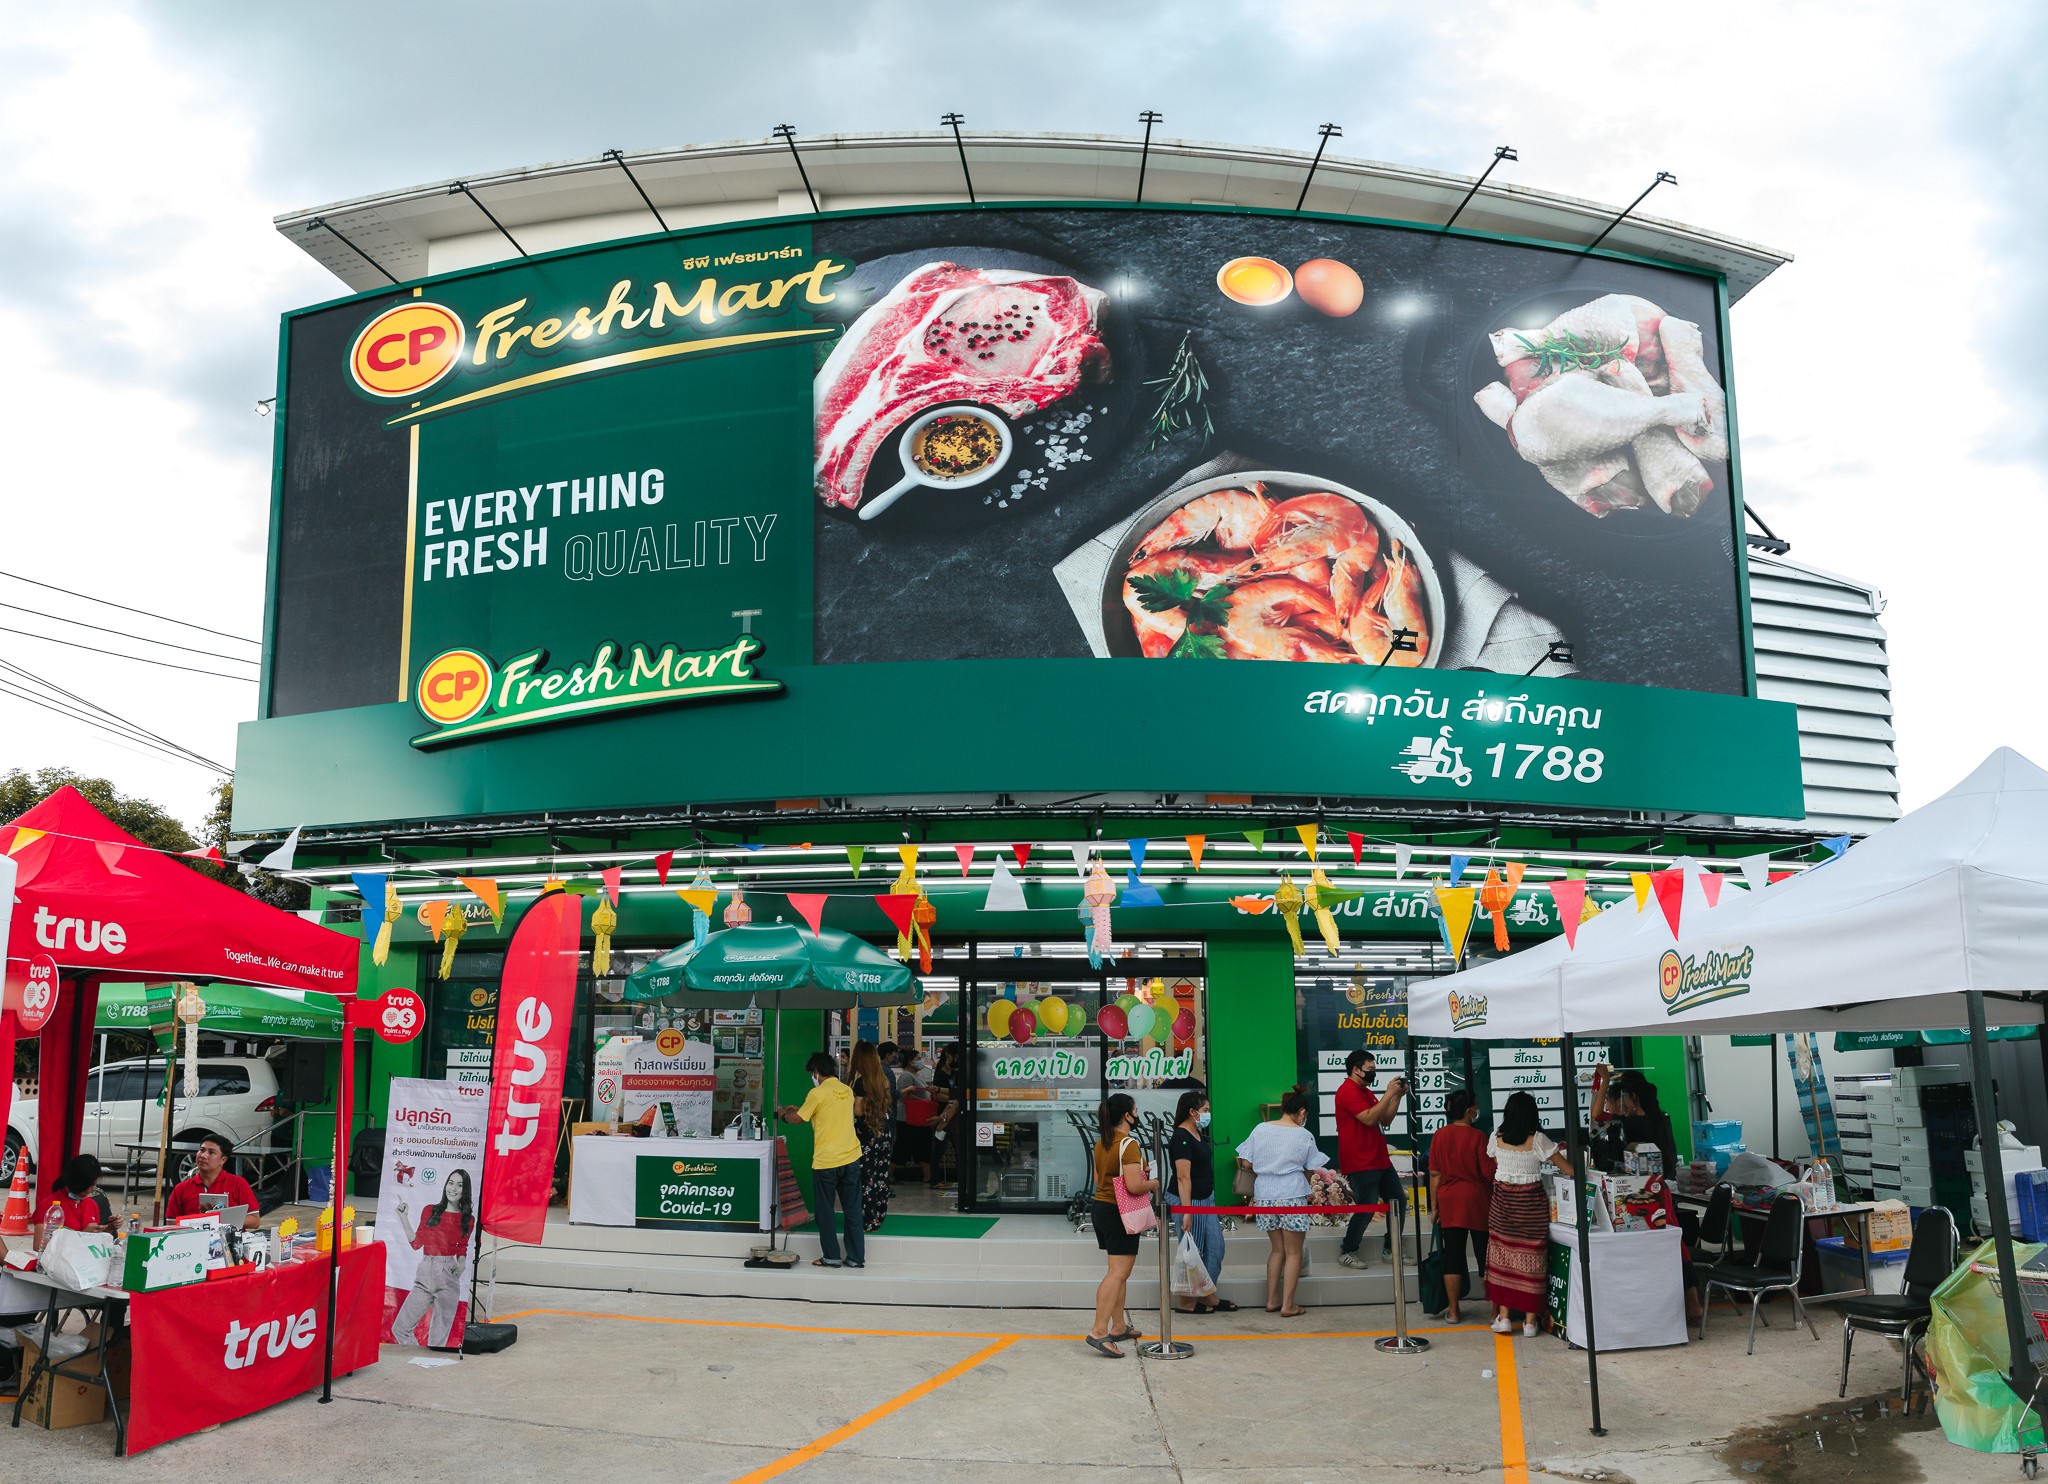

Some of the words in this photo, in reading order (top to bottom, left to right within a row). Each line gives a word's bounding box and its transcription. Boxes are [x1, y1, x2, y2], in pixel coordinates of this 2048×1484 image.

[682, 254, 710, 271] ซีพี
[713, 245, 803, 268] เฟรชมาร์ท
[366, 324, 448, 373] CP
[424, 468, 665, 538] EVERYTHING
[423, 526, 548, 582] FRESH
[564, 513, 778, 583] QUALITY
[427, 669, 480, 704] CP
[1303, 687, 1448, 726] สดทุกวัน
[1460, 689, 1603, 736] ส่งถึงคุณ
[1484, 742, 1605, 785] 1788
[33, 905, 127, 955] true
[30, 963, 51, 979] true
[281, 960, 298, 973] can
[299, 963, 321, 977] make
[321, 966, 328, 977] it
[327, 968, 344, 979] true
[1663, 965, 1679, 987] CP
[656, 976, 670, 987] 1788
[858, 973, 882, 984] 1788
[387, 993, 415, 1007] true
[473, 993, 486, 1002] CP
[120, 1005, 149, 1017] 1788
[659, 1036, 681, 1049] CP
[1365, 1032, 1395, 1045] ไก่สด
[994, 1051, 1086, 1078] ฉลองเปิด
[1107, 1048, 1191, 1078] สาขาใหม่
[1420, 1053, 1441, 1065] 55
[1514, 1049, 1544, 1063] ซี่โครง
[634, 1056, 706, 1074] กุ้งสดพรีเมี่ยม
[495, 996, 553, 1157] true
[627, 1076, 712, 1088] ส่งตรงจากฟาร์มทุกวัน
[1421, 1074, 1443, 1088] 98
[1513, 1069, 1547, 1084] สามชั้น
[458, 1085, 485, 1097] true
[1422, 1096, 1444, 1109] 63
[395, 1107, 452, 1128] ปลูกรัก
[1424, 1117, 1446, 1131] 40
[659, 1181, 736, 1200] จุดคัดกรอง
[659, 1200, 733, 1216] Covid-19
[223, 1307, 317, 1371] true
